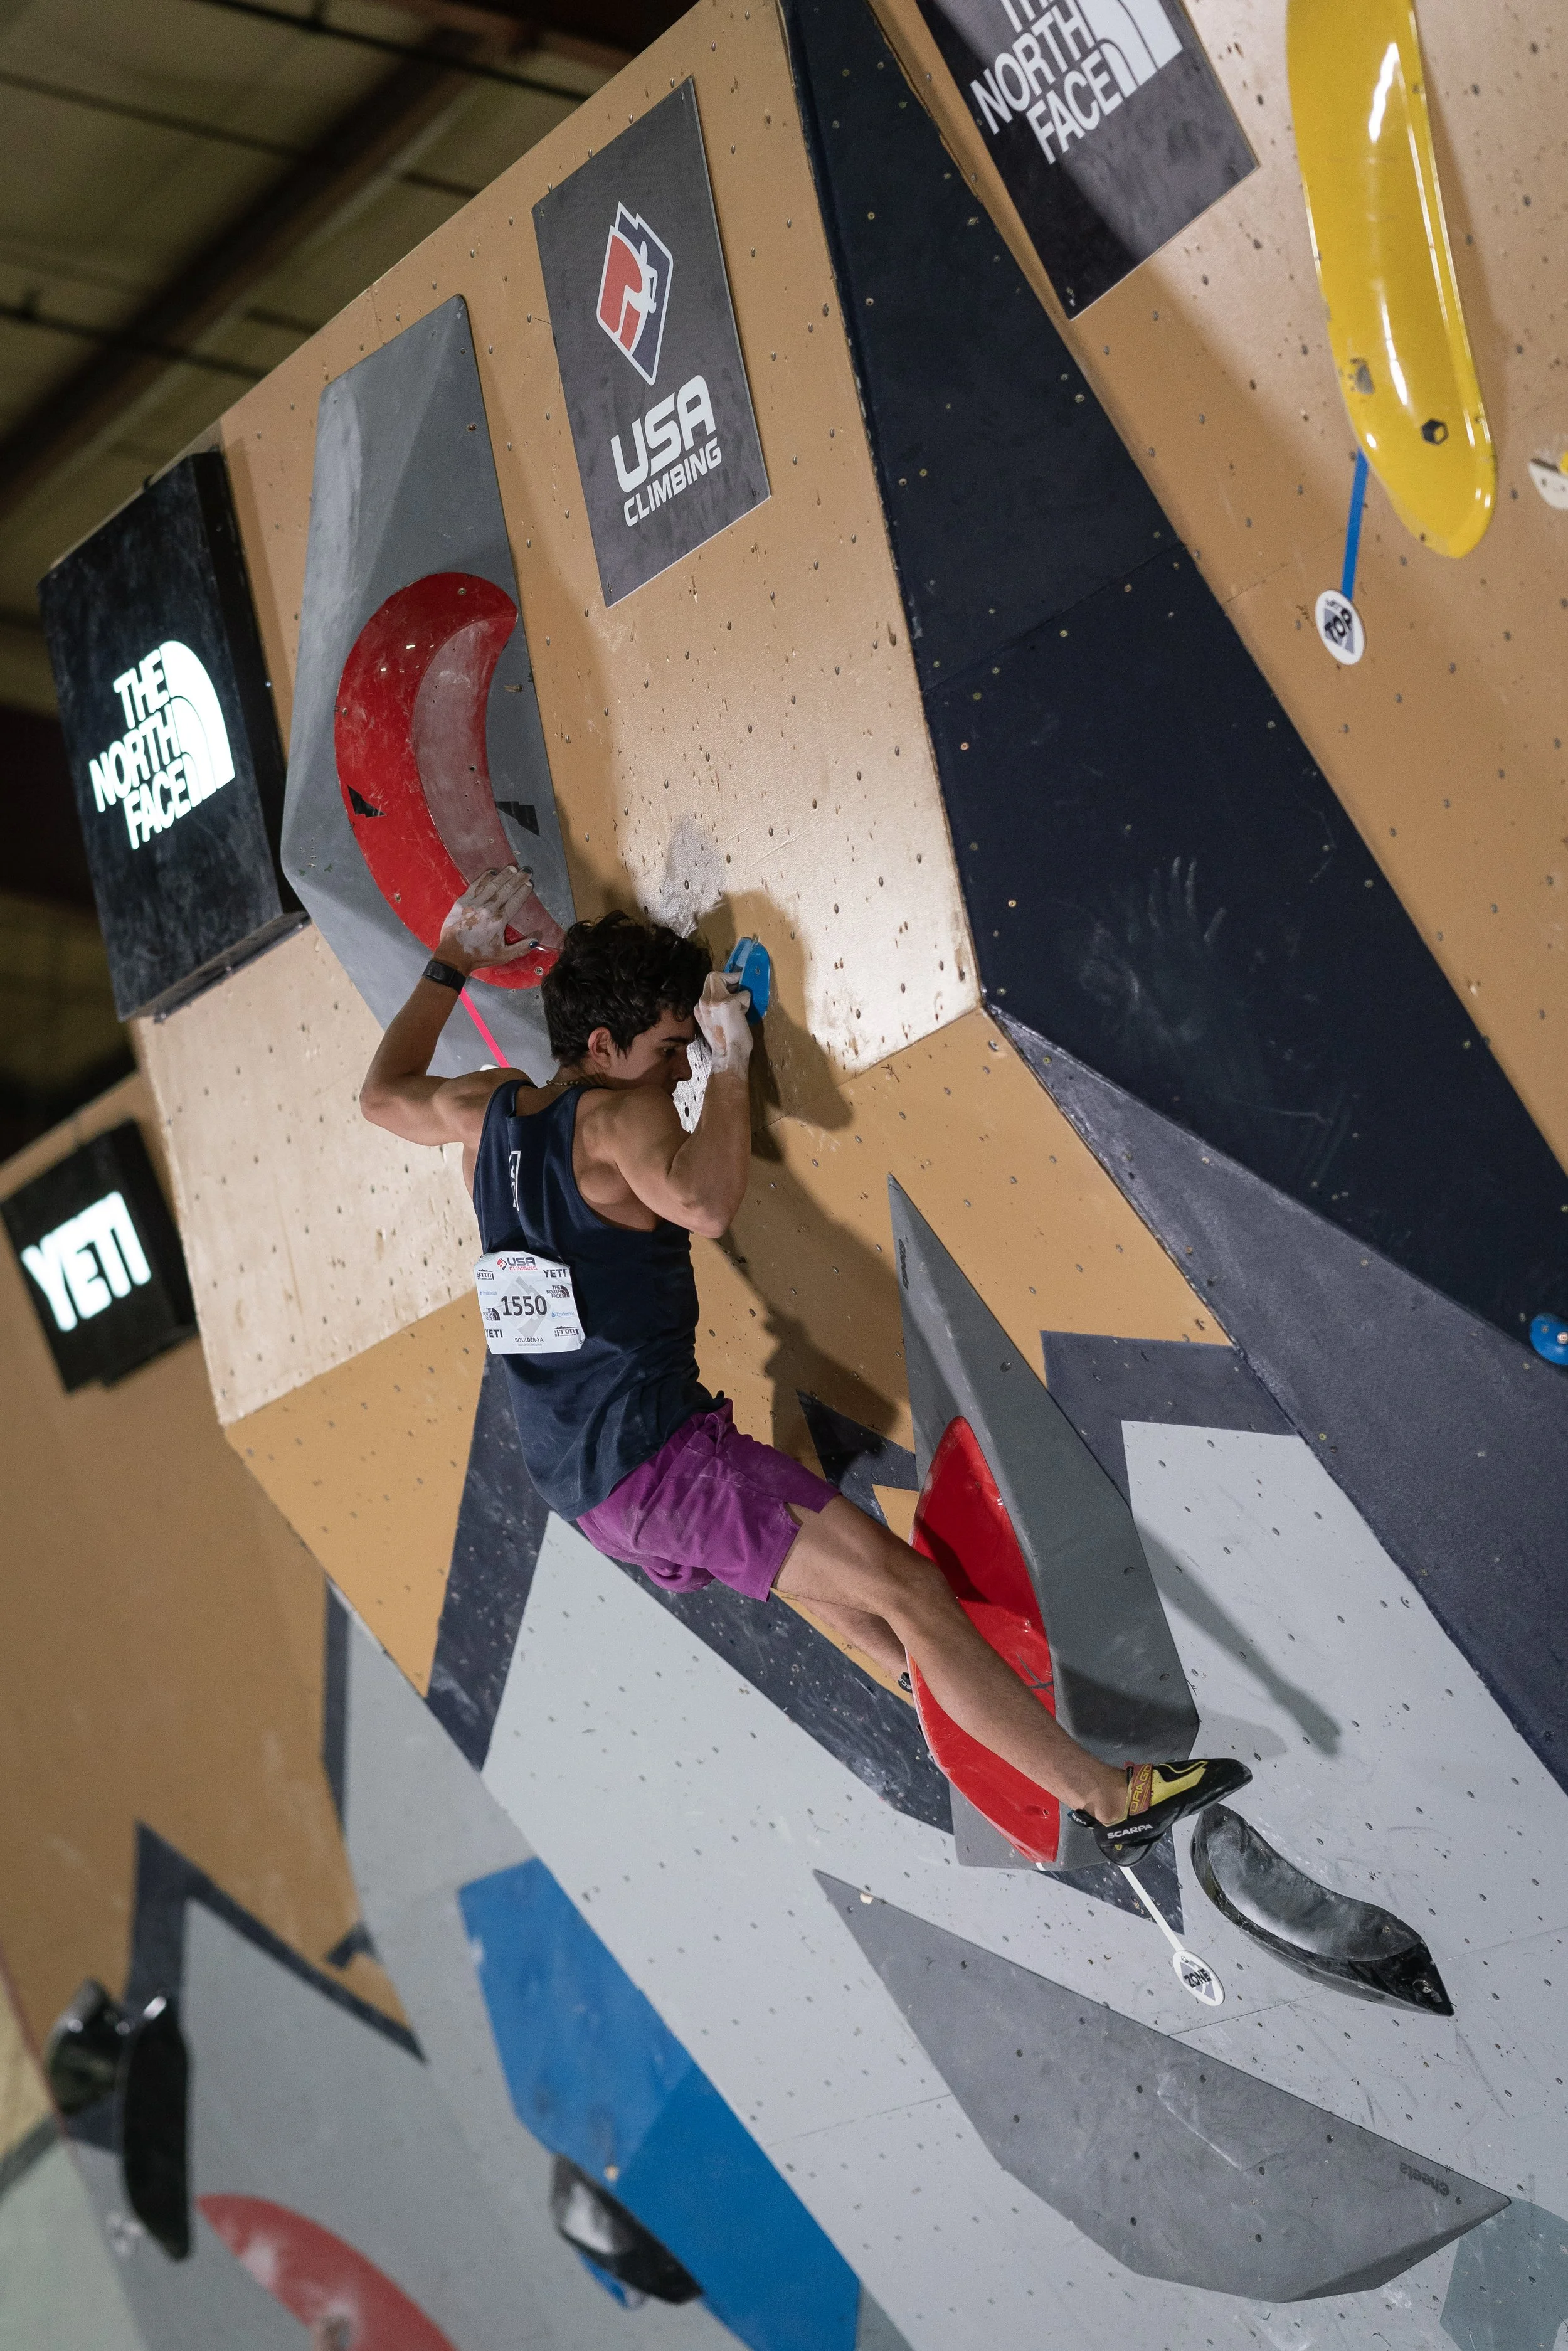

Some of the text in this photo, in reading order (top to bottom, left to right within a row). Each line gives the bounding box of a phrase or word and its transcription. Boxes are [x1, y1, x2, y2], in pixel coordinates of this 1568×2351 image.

[970, 0, 1095, 135] NORTH
[1026, 50, 1123, 165] FACE
[610, 375, 716, 493] USA
[623, 437, 722, 527] CLIMBING
[1324, 608, 1353, 644] TOP
[113, 649, 171, 730] THE
[89, 702, 181, 813] NORTH
[123, 757, 192, 850] FACE
[20, 1190, 152, 1332] YETI
[506, 1257, 536, 1266] USA
[543, 1268, 567, 1278] YETI
[501, 1295, 548, 1316] 1550
[1130, 1765, 1152, 1812] DRAGO
[1107, 1823, 1153, 1839] SCARPA
[1183, 1968, 1212, 1988] ZONE
